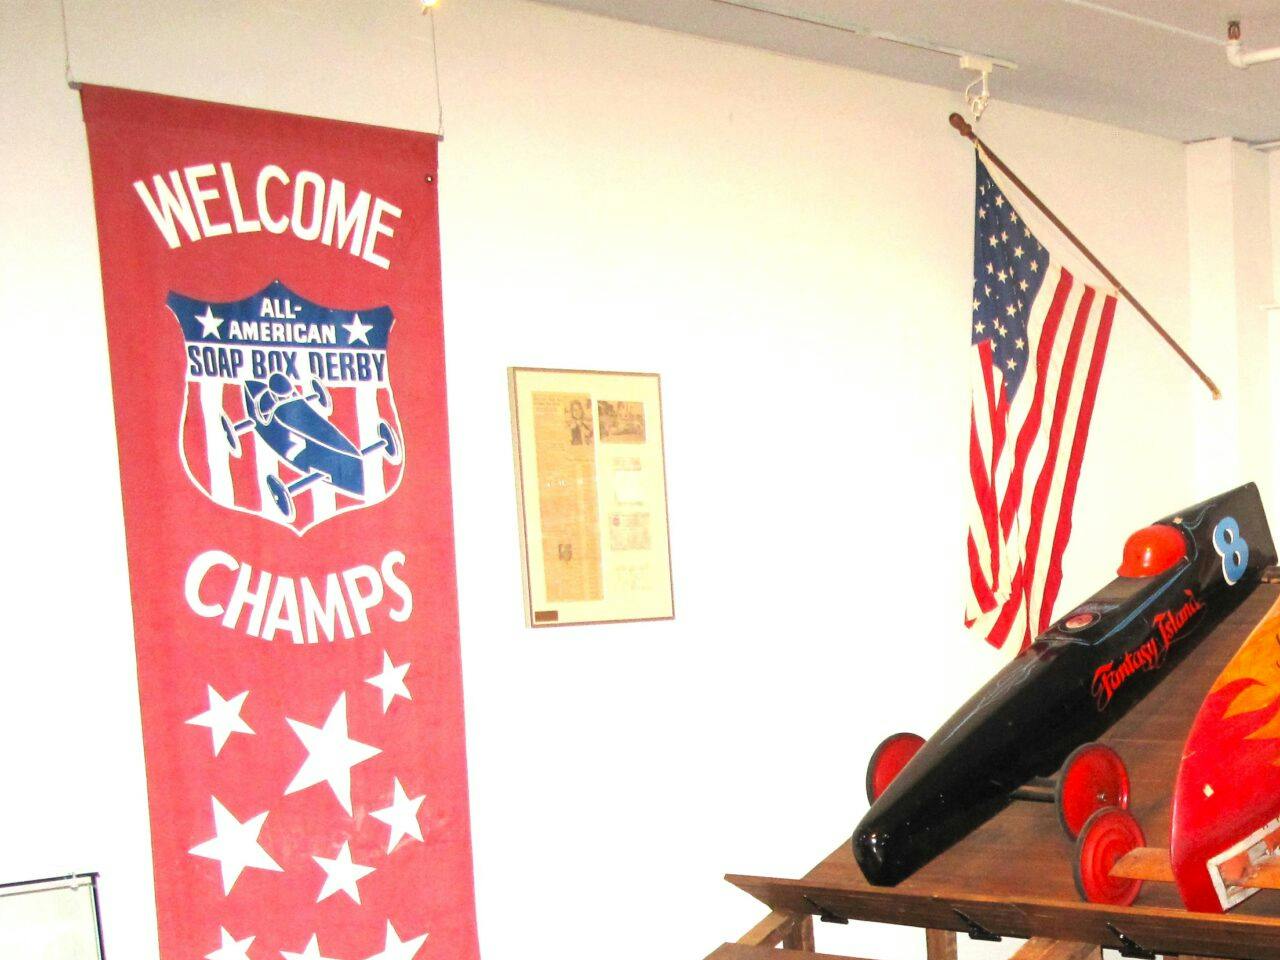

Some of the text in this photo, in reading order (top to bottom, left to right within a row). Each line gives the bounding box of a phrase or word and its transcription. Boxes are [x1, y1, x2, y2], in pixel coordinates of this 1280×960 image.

[133, 162, 402, 270] WELCOME
[260, 297, 302, 319] ALL-
[228, 320, 336, 344] AMERICAN
[187, 344, 386, 381] SOAP BOX DERBY
[285, 431, 307, 461] 7
[1212, 516, 1249, 586] 8
[185, 550, 413, 644] CHAMPS
